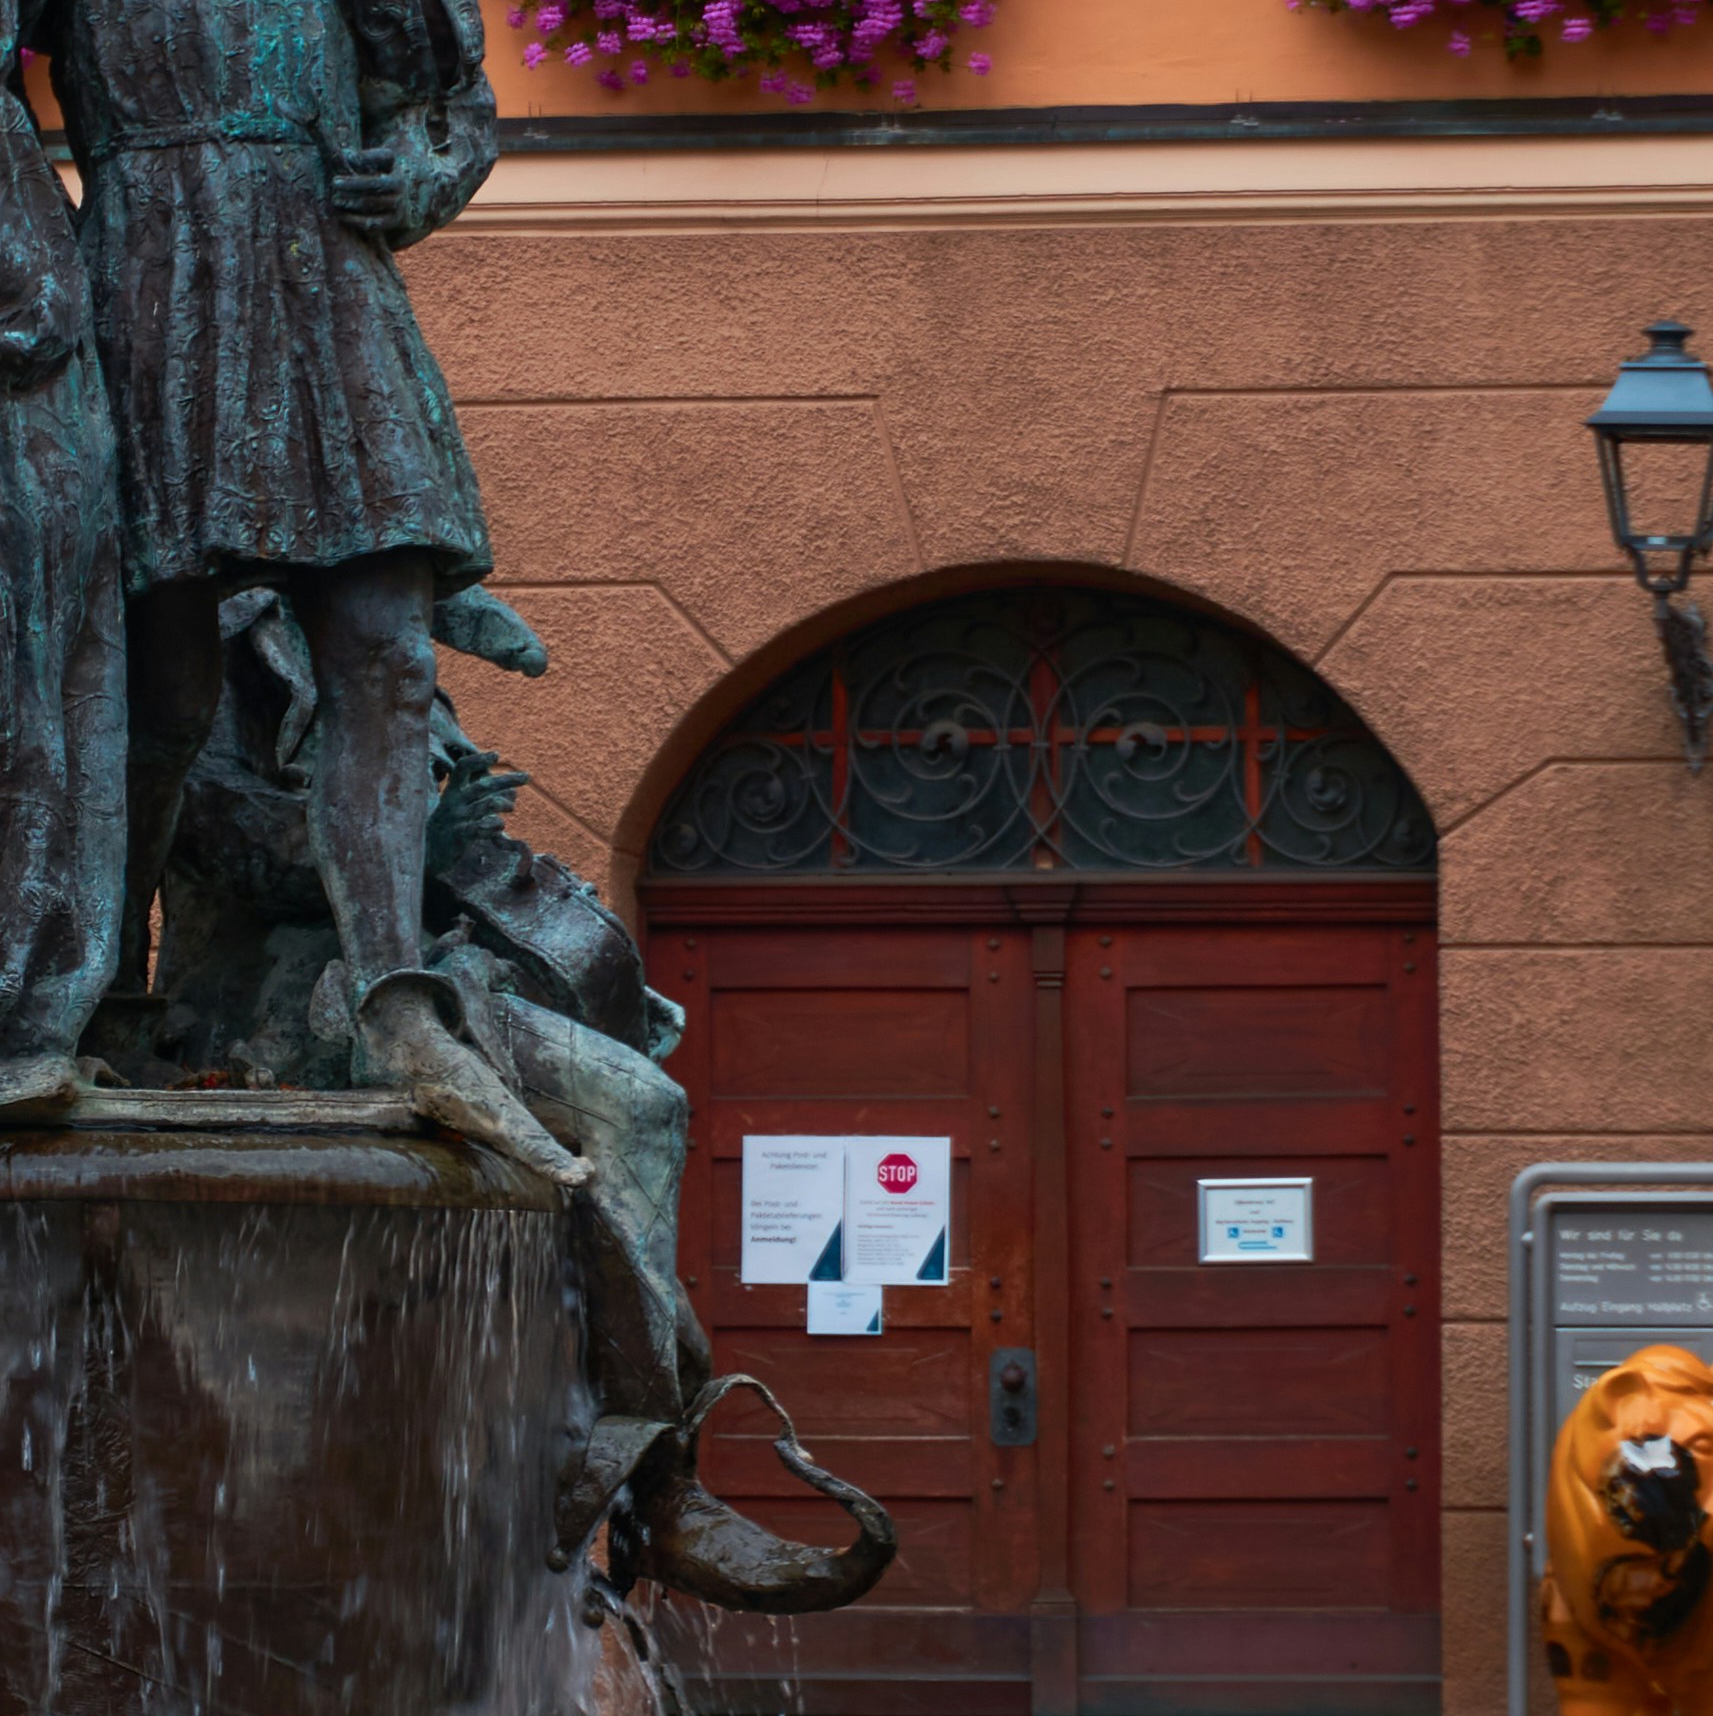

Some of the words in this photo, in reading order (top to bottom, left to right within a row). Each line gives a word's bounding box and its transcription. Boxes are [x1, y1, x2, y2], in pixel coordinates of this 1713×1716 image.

[879, 1166, 916, 1182] STOP
[1559, 1230, 1580, 1240] Wir
[1588, 1230, 1612, 1241] sind
[1618, 1230, 1635, 1241] für
[1642, 1229, 1661, 1241] Sie
[1667, 1231, 1682, 1241] da
[1601, 1300, 1643, 1314] Eingang
